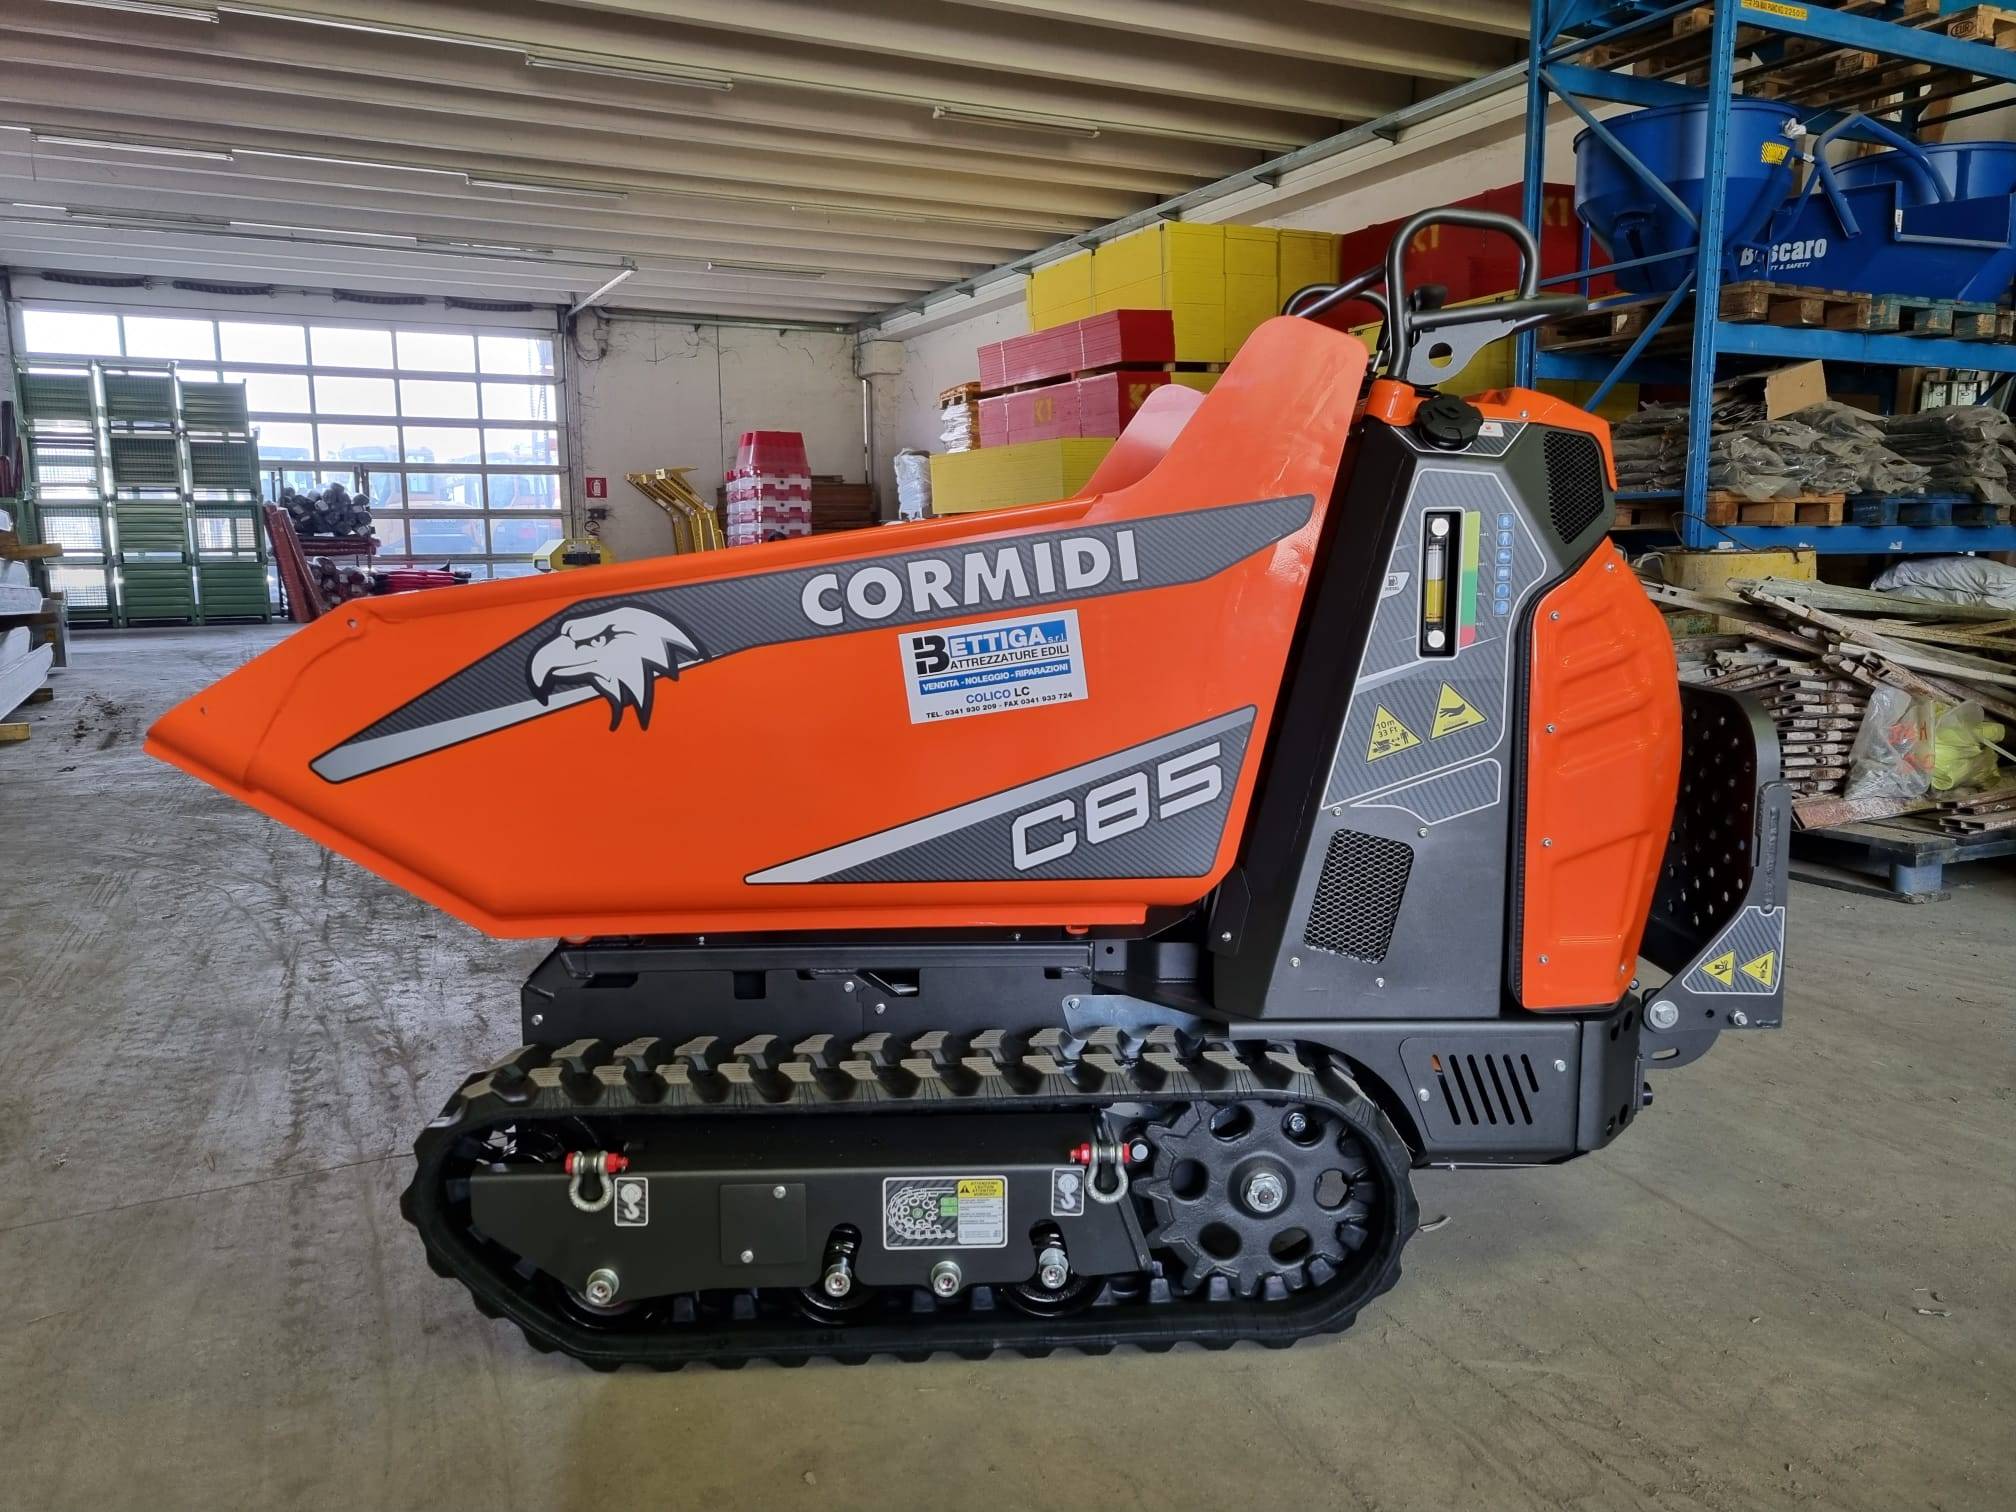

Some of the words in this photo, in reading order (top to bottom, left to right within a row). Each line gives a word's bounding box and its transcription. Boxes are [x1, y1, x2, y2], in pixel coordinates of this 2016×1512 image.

[1740, 238, 1827, 267] Bscaro
[1785, 261, 1811, 269] SAFETY
[802, 529, 1139, 626] CORMIDI
[912, 627, 1046, 675] BETTIGA
[950, 651, 1039, 670] ATTREZZATURE
[1041, 645, 1070, 656] EDILI
[922, 681, 960, 692] VENDITA
[965, 673, 1009, 684] NOLEGGIO
[1015, 663, 1068, 678] RIPARAZIONI
[945, 708, 963, 717] 0341
[966, 705, 981, 713] 930
[982, 703, 998, 711] 209
[1004, 700, 1019, 708] FAX
[1020, 697, 1040, 706] 0341
[1042, 694, 1056, 703] 933
[1058, 691, 1073, 700] 724
[966, 689, 1011, 704] COLICO
[1014, 686, 1030, 698] LC
[1376, 719, 1395, 730] 10m
[1378, 729, 1389, 738] 33
[1011, 741, 1223, 872] C85
